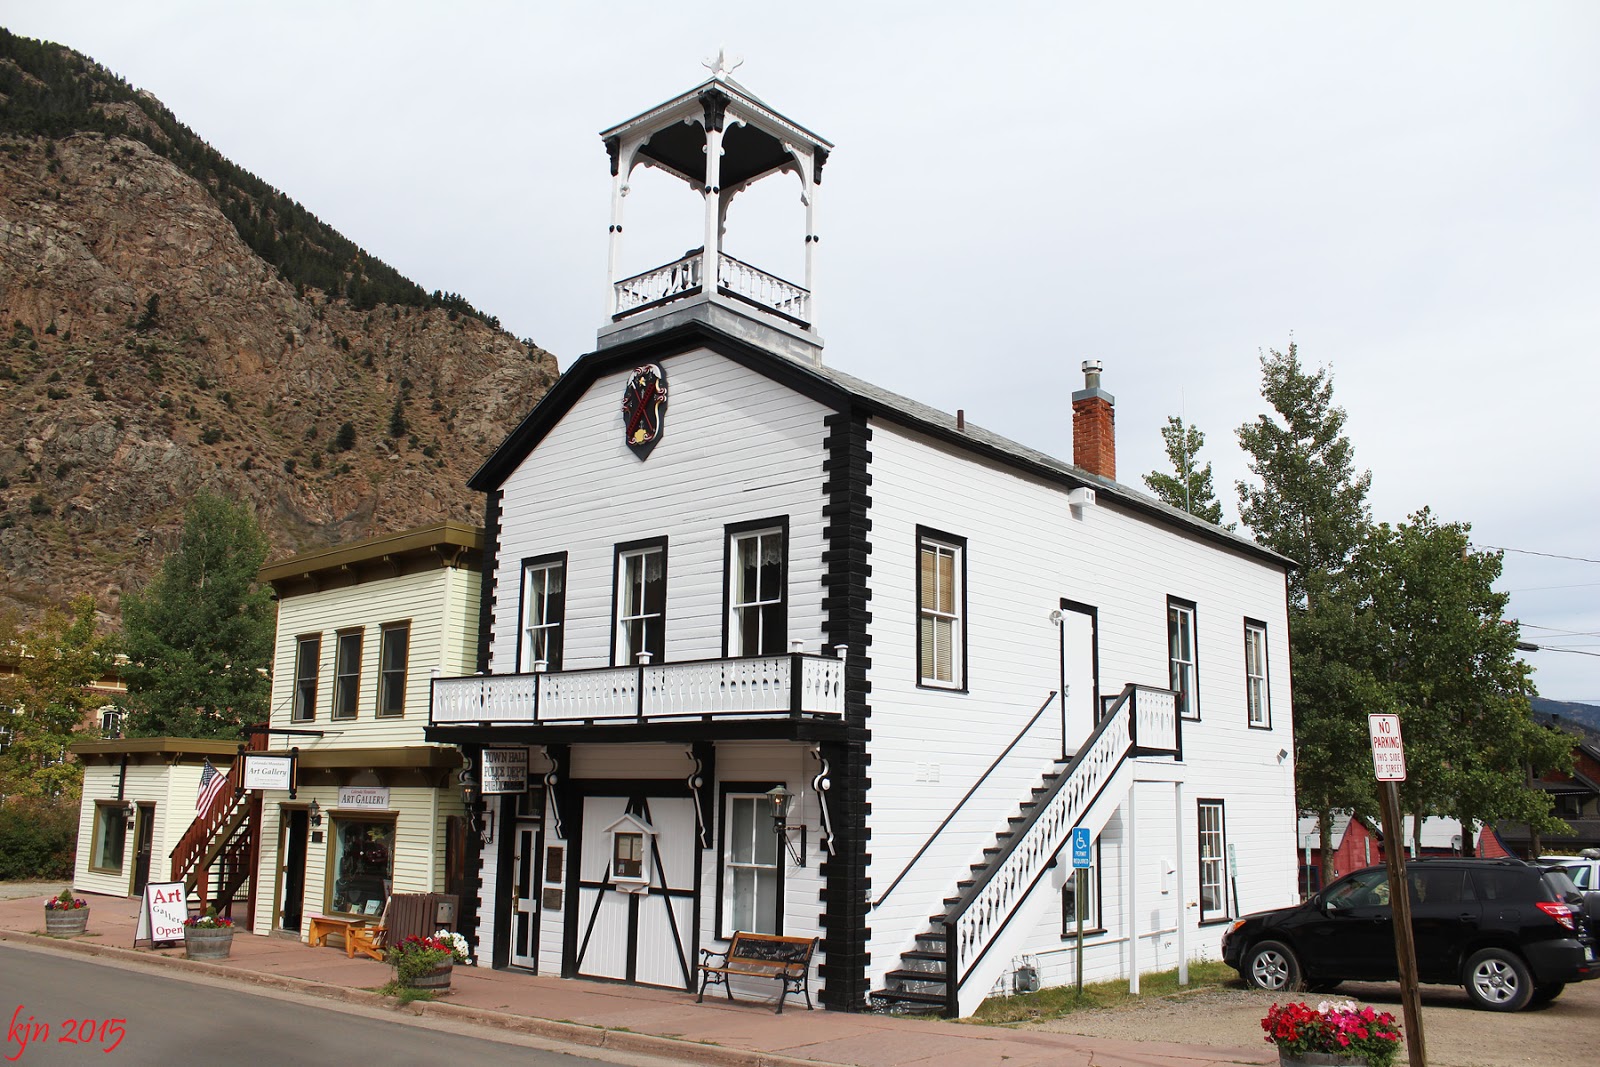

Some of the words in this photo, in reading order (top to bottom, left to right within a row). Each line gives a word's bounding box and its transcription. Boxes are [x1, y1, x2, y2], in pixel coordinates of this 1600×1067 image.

[1378, 722, 1390, 733] NO
[1374, 737, 1399, 748] PARKING
[484, 752, 507, 763] TOWN
[508, 752, 526, 762] HALL
[1377, 754, 1388, 762] THIS
[1390, 753, 1401, 762] SIDE
[262, 768, 287, 777] Gallery
[1378, 765, 1384, 773] OF
[1386, 765, 1403, 773] STREET
[341, 794, 355, 804] ART
[356, 795, 385, 805] GALLERY
[153, 889, 182, 904] Art
[156, 926, 183, 937] Open
